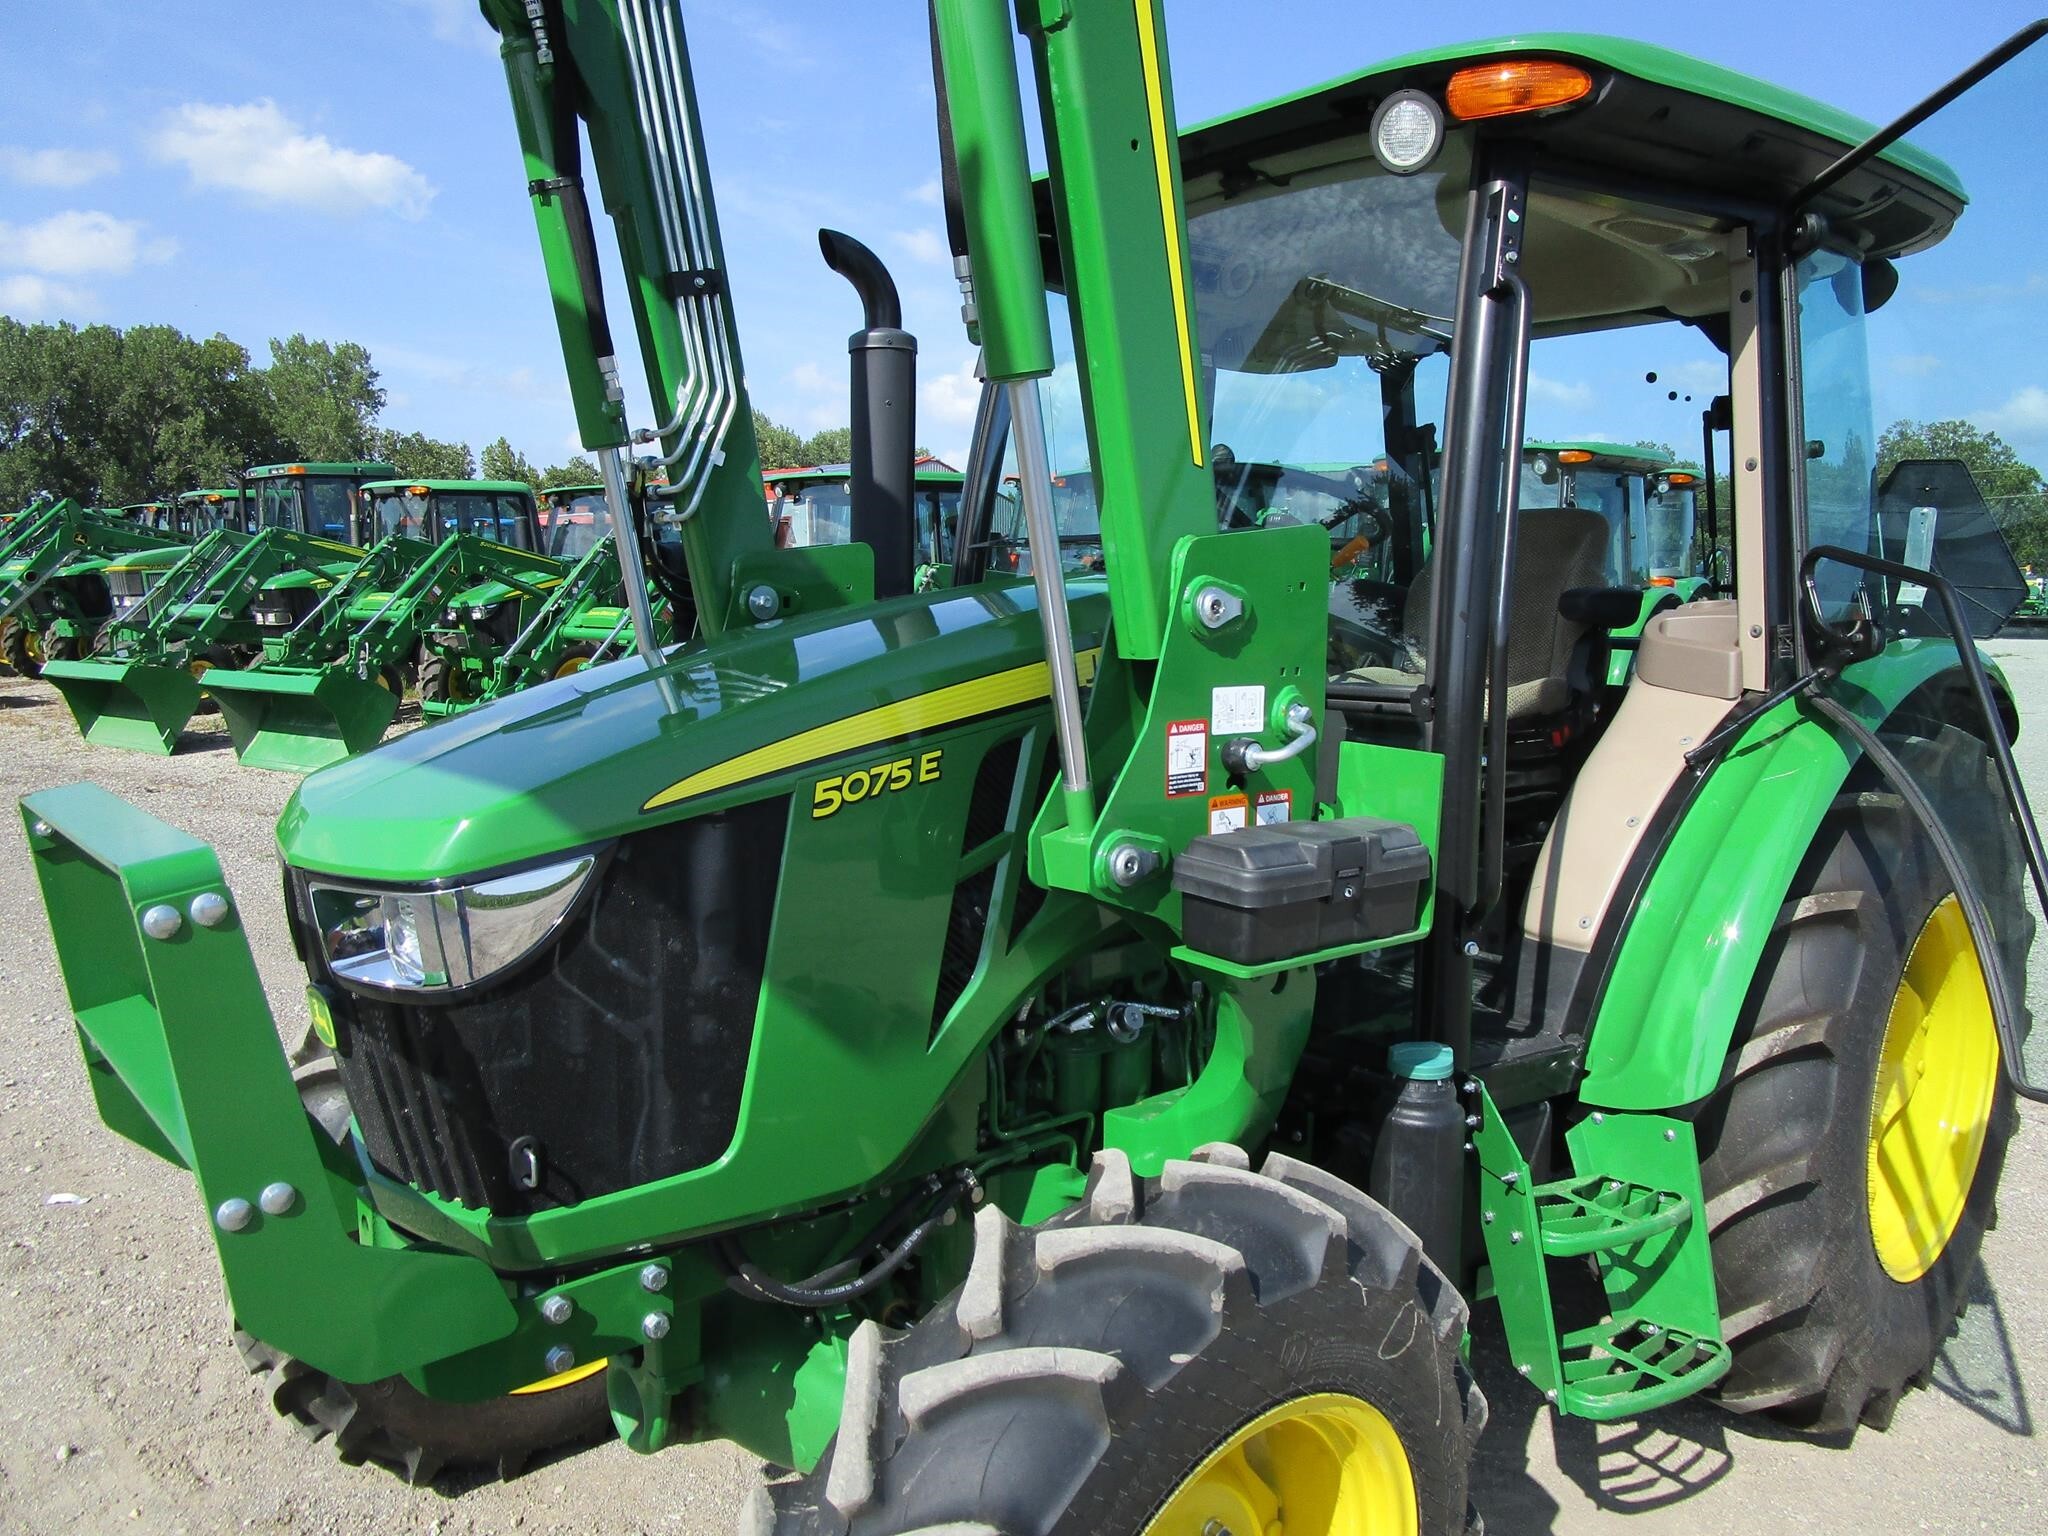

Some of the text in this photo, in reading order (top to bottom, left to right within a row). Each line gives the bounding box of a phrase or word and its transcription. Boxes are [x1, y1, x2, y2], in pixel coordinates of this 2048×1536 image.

[1178, 723, 1205, 733] DANGER
[812, 749, 943, 819] 5075 E
[1218, 797, 1246, 807] WARNING
[1265, 793, 1289, 803] DANGER
